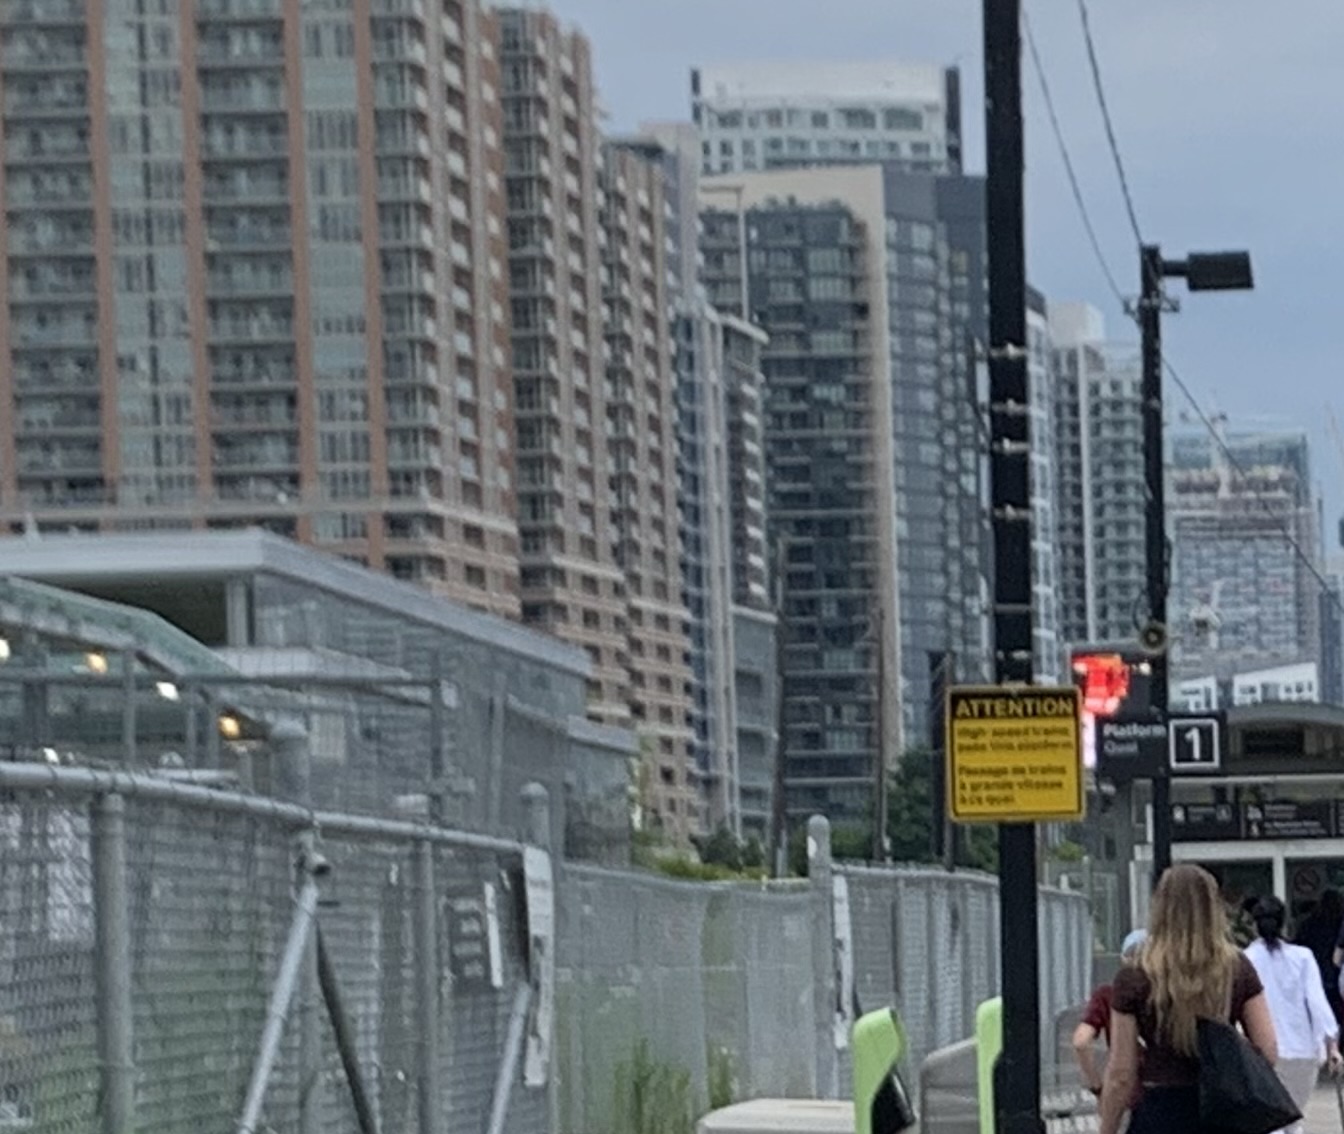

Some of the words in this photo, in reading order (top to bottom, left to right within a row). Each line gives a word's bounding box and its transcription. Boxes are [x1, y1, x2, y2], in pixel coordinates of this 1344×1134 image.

[956, 698, 1074, 717] ATTENTION
[1103, 723, 1167, 738] Platform
[1185, 727, 1201, 761] 1
